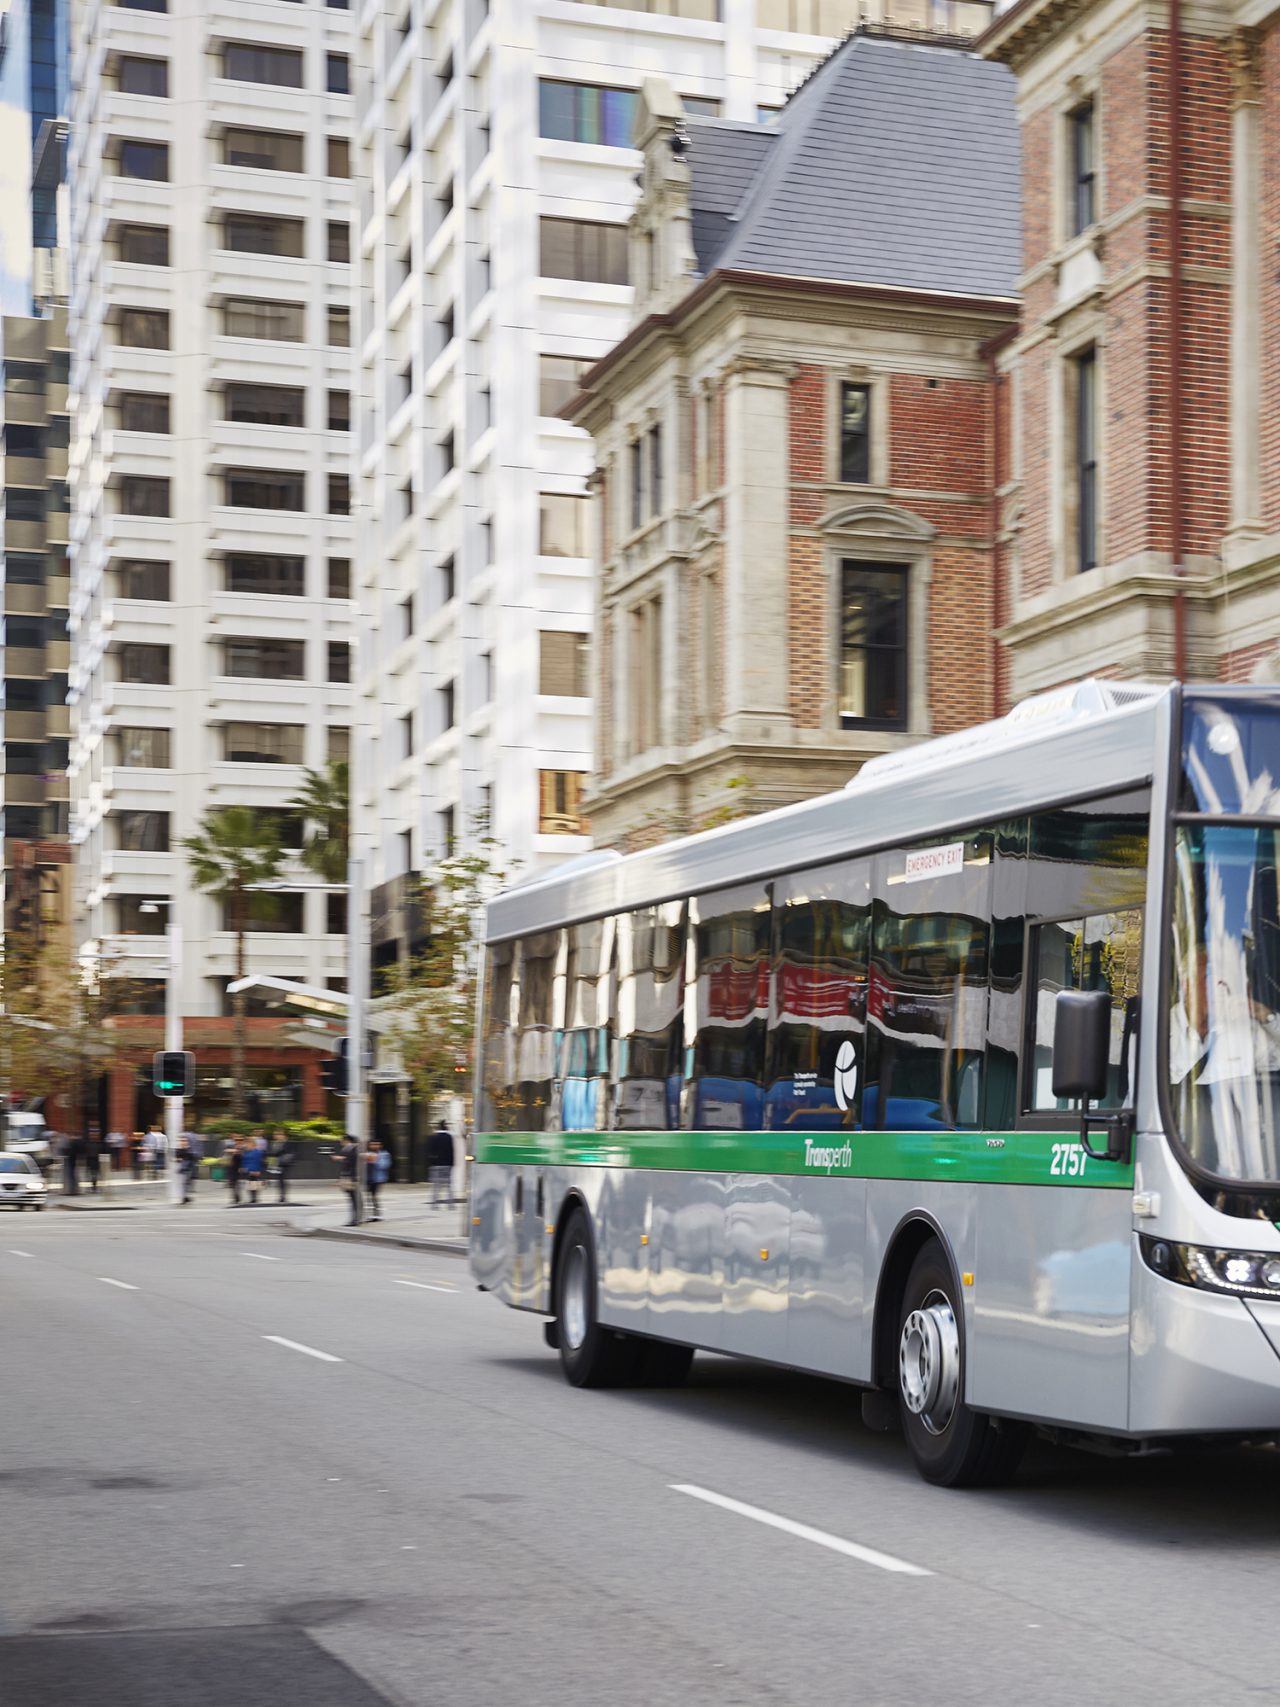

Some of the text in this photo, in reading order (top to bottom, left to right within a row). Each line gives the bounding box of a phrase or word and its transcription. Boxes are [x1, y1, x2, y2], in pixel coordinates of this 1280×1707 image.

[907, 847, 962, 873] EMERGENCY EXIT
[804, 1138, 852, 1175] Transperth
[1050, 1143, 1088, 1176] 2757
